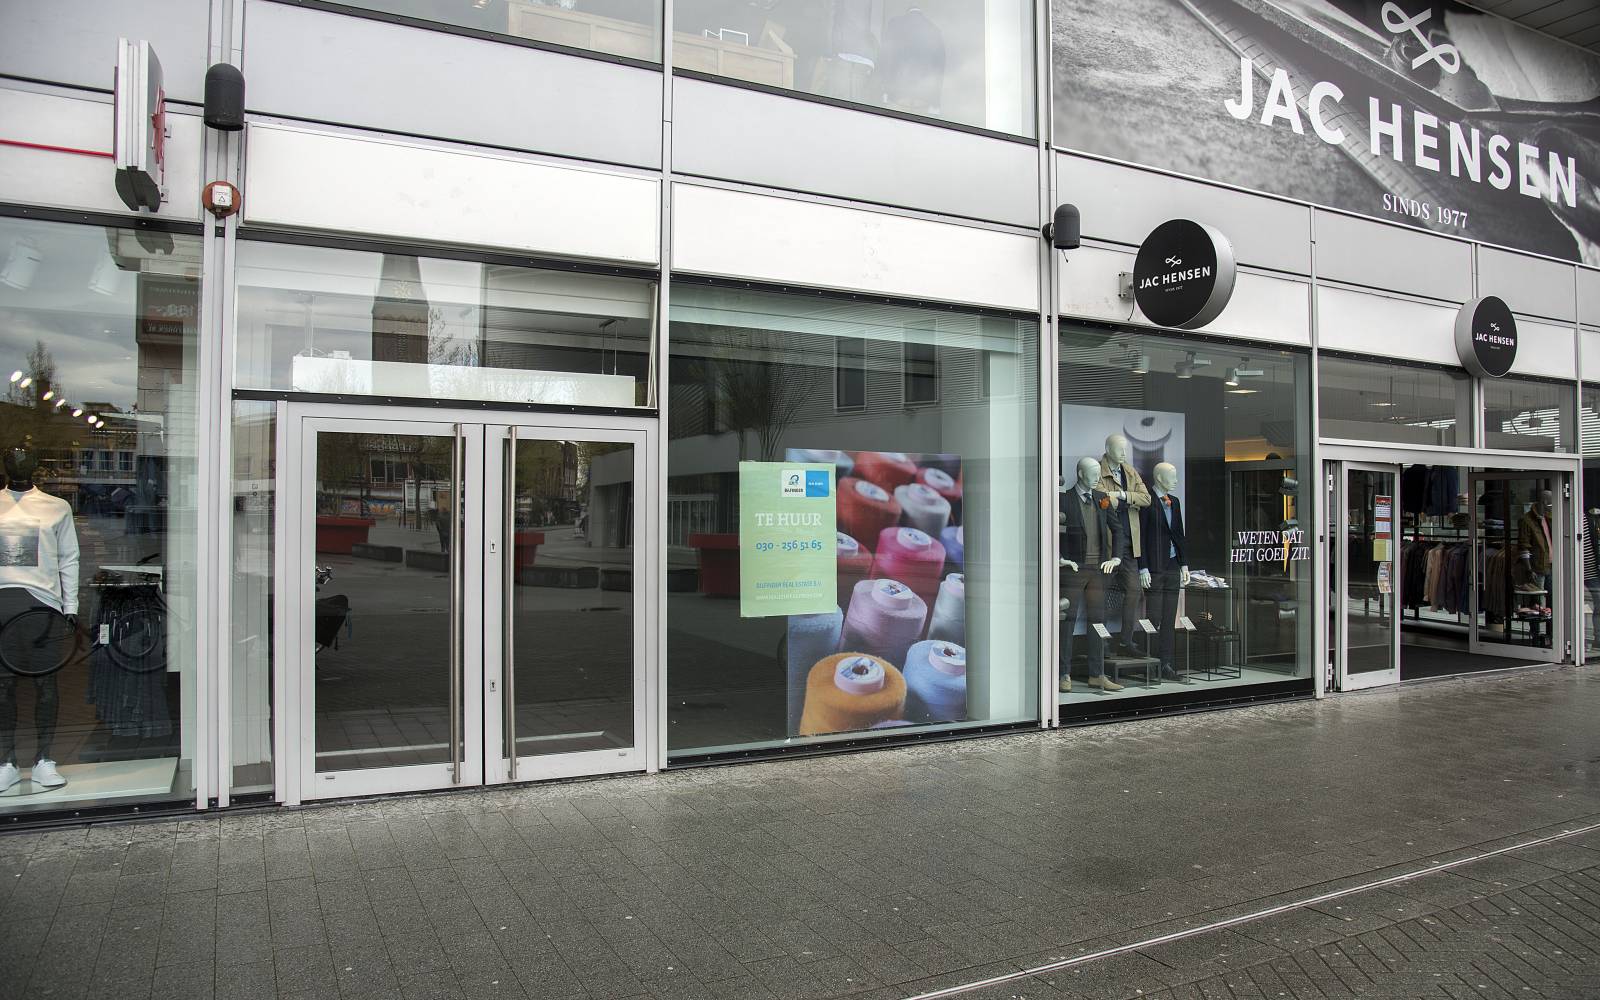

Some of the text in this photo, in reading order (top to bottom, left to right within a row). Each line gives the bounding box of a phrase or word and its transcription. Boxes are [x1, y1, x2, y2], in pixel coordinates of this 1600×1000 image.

[1224, 57, 1577, 208] JAC HENSEN
[1382, 193, 1468, 229] SINDS 1977
[1139, 276, 1159, 289] JAC
[1162, 265, 1211, 285] HENSEN
[1475, 332, 1515, 347] JAC HENSEN
[755, 512, 822, 526] TE HUUR
[756, 542, 774, 551] 030
[782, 540, 798, 551] 256
[800, 541, 809, 551] 51
[811, 539, 822, 551] 65
[1237, 530, 1304, 545] WETEN DAT
[1230, 546, 1310, 562] HET GOED ZIT.
